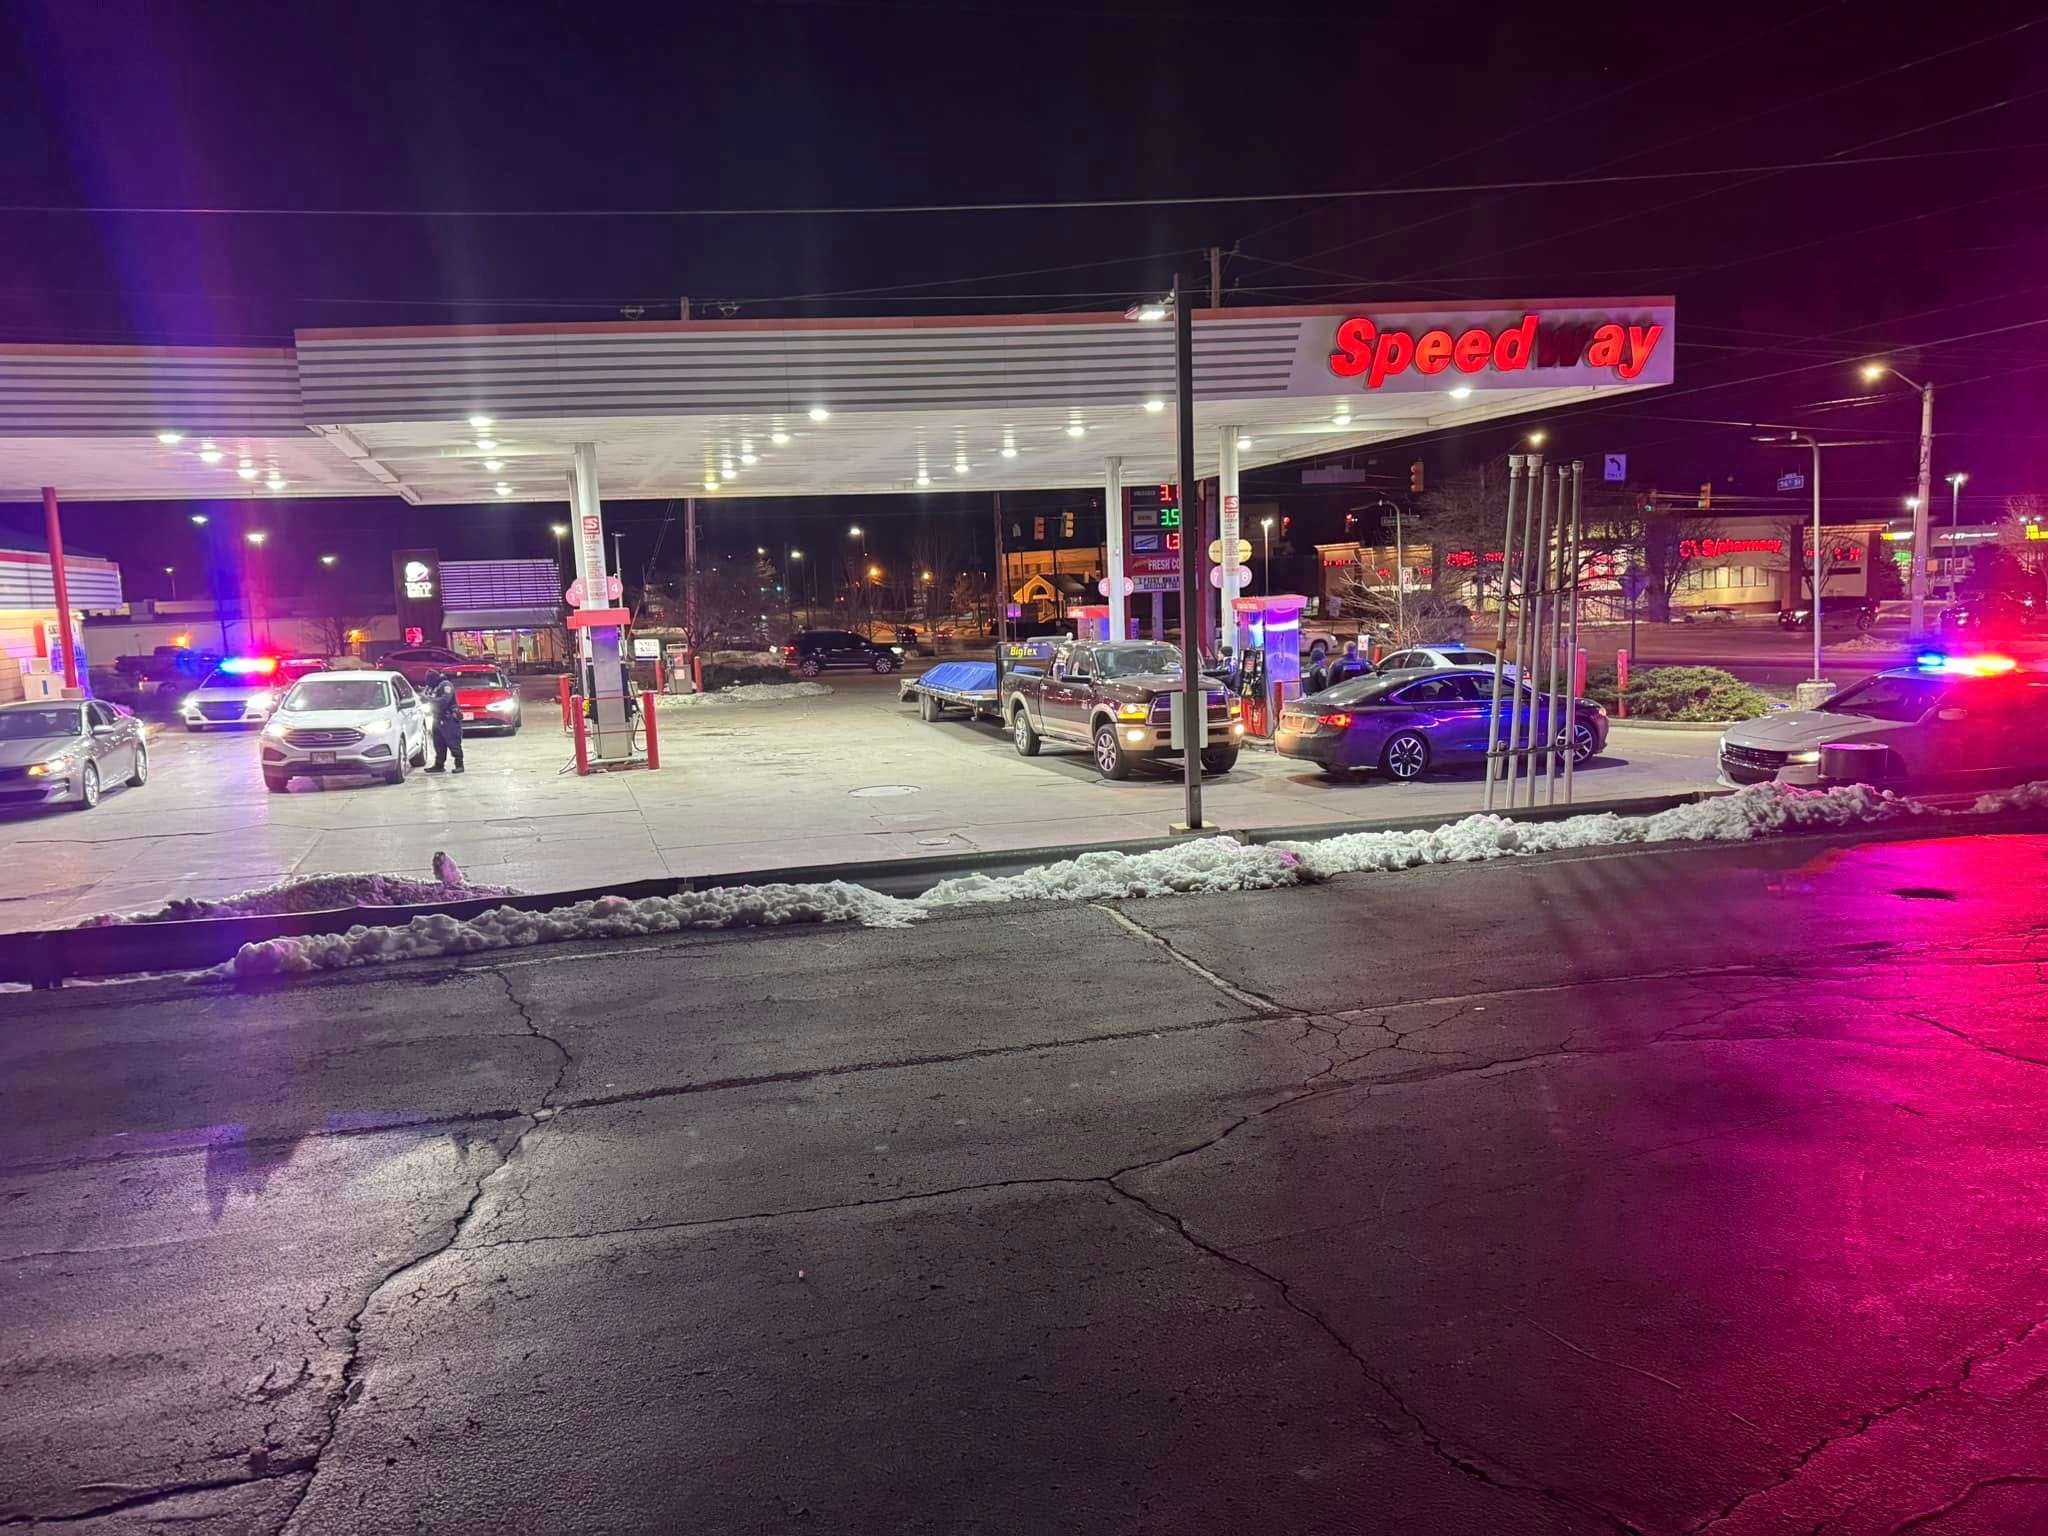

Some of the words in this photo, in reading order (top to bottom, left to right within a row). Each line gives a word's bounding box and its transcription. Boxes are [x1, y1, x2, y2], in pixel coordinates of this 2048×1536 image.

[1330, 313, 1664, 389] Speedway
[1148, 559, 1171, 571] FRESH
[575, 583, 583, 594] 3
[1009, 646, 1037, 657] BigTex
